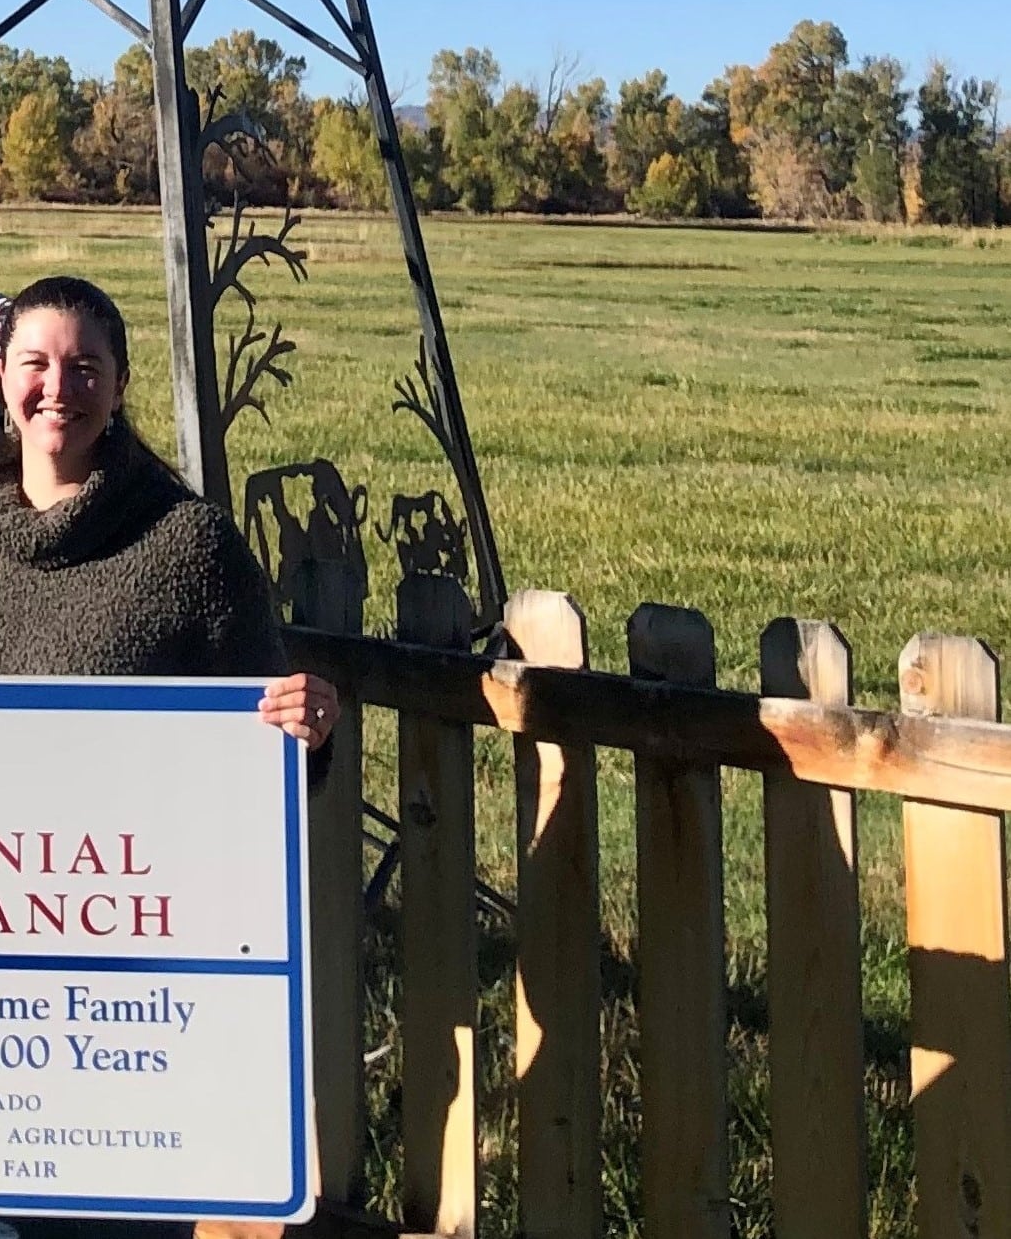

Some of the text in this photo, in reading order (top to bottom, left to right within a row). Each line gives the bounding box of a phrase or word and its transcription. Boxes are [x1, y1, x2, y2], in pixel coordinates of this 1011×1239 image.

[64, 986, 195, 1033] Family
[65, 1035, 167, 1072] Years
[8, 1128, 181, 1148] AGRICULTURE
[5, 1160, 57, 1178] FAIR
